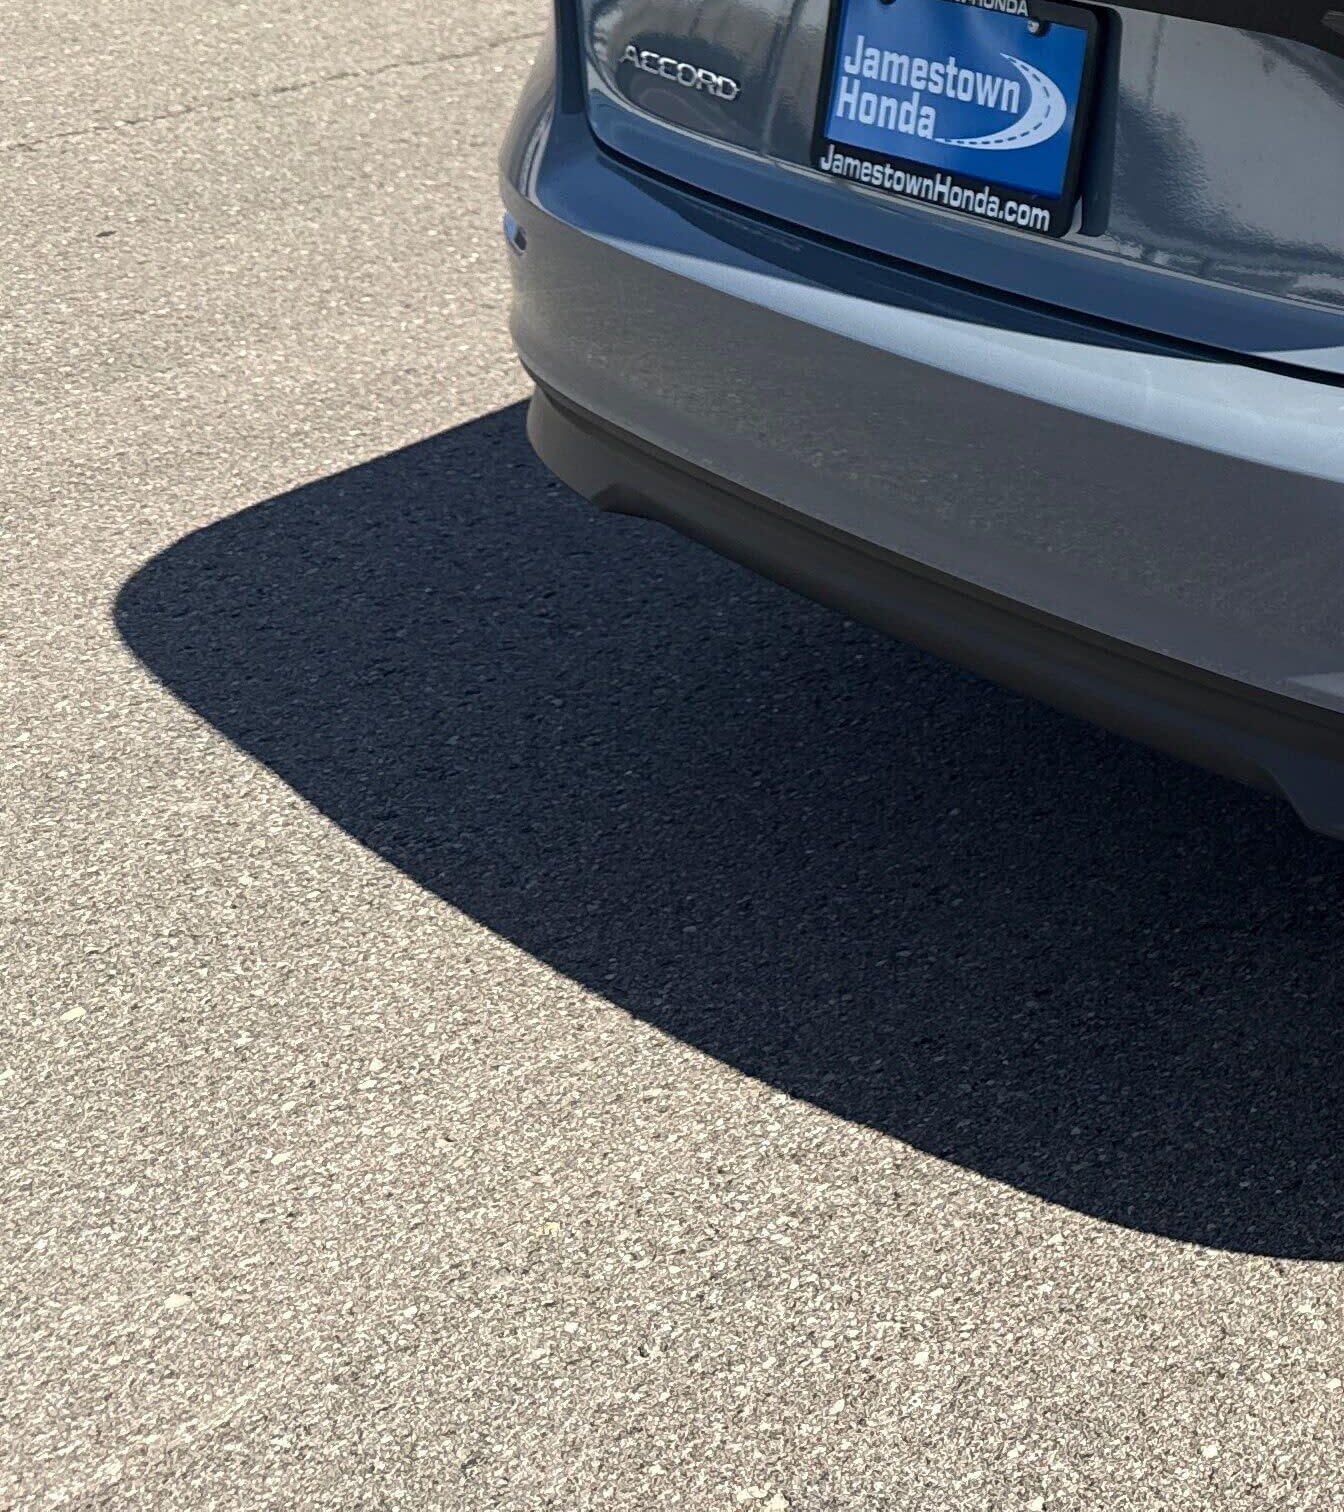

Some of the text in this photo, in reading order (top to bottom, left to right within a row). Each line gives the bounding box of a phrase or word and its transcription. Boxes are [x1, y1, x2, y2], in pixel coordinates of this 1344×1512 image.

[619, 45, 739, 101] ACCORD
[836, 76, 936, 140] Honda
[844, 35, 1021, 114] Jamestown
[820, 143, 1051, 232] JamestownHonda.com
